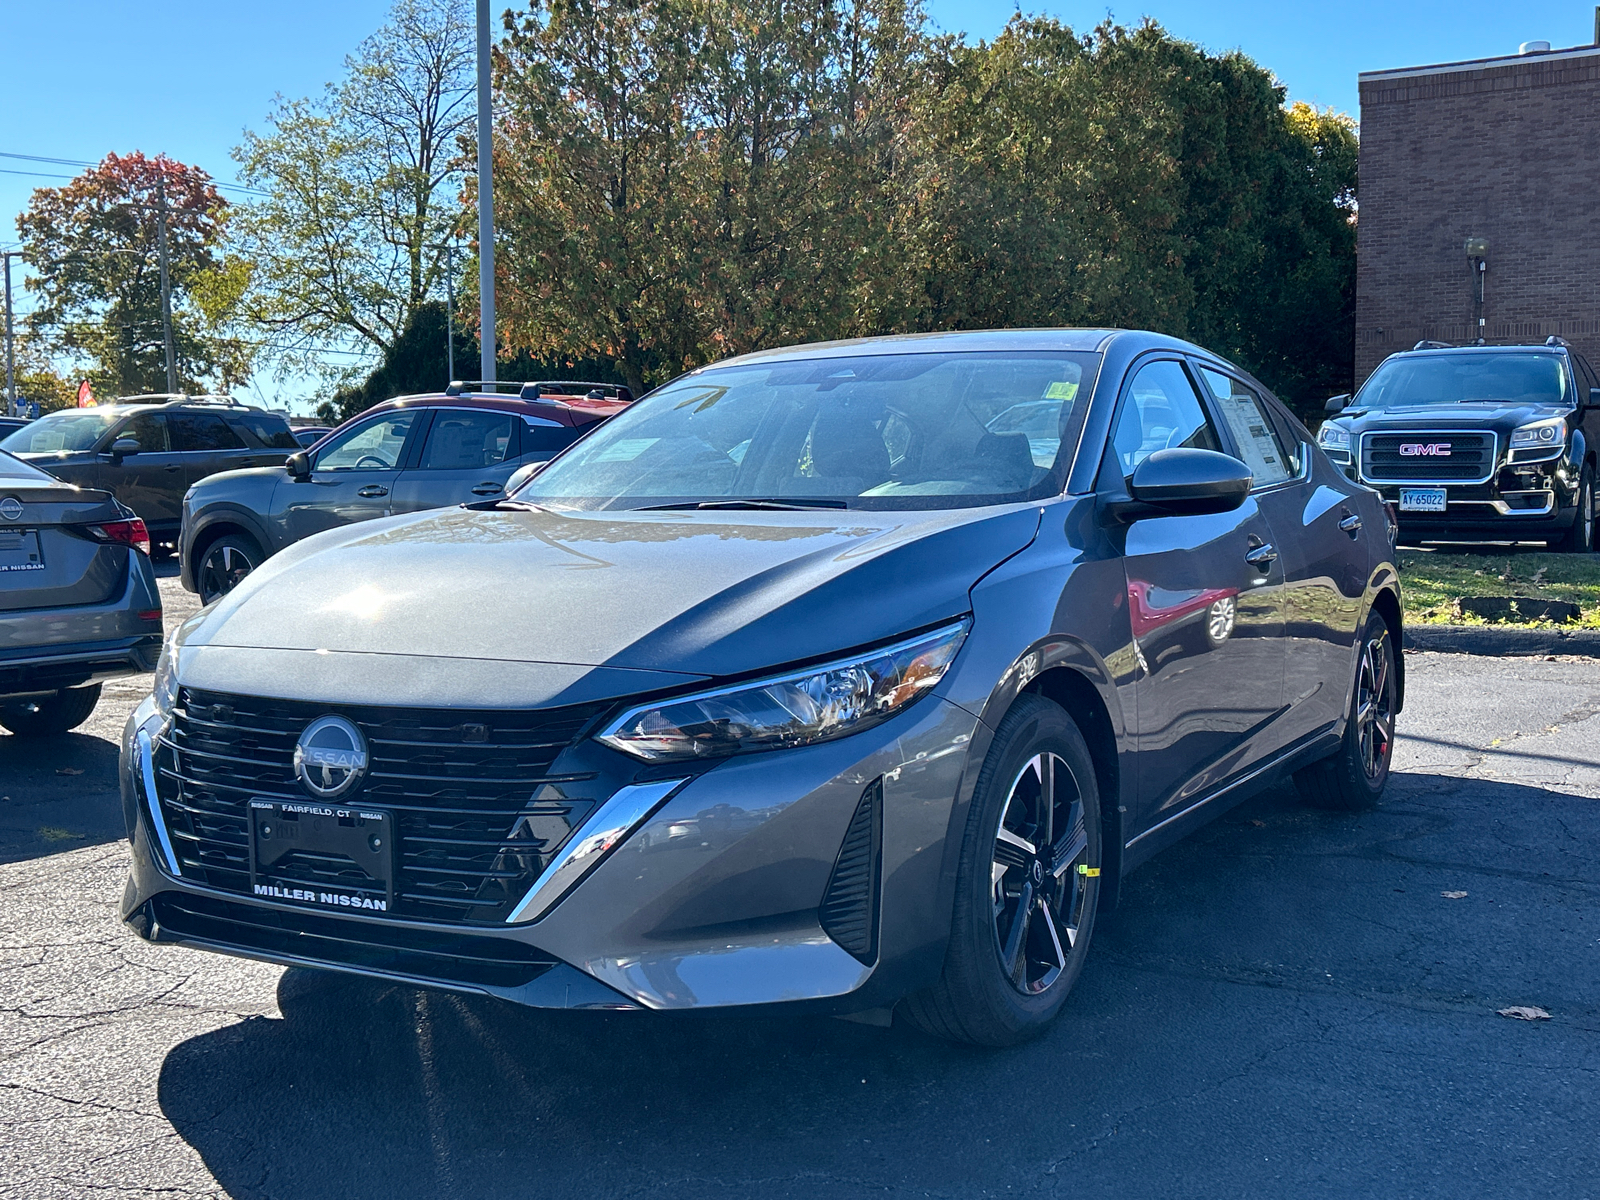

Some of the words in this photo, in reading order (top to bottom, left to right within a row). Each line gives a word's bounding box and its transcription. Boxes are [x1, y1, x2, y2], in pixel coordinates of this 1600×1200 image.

[1400, 444, 1451, 456] GMC
[10, 563, 45, 571] NISSAN
[251, 802, 274, 810] NISSAN
[281, 804, 335, 818] FAIRFIELD,
[337, 809, 351, 818] CT
[360, 812, 383, 821] NISSAN
[254, 884, 316, 902] MILLER
[320, 892, 387, 911] NISSAN
